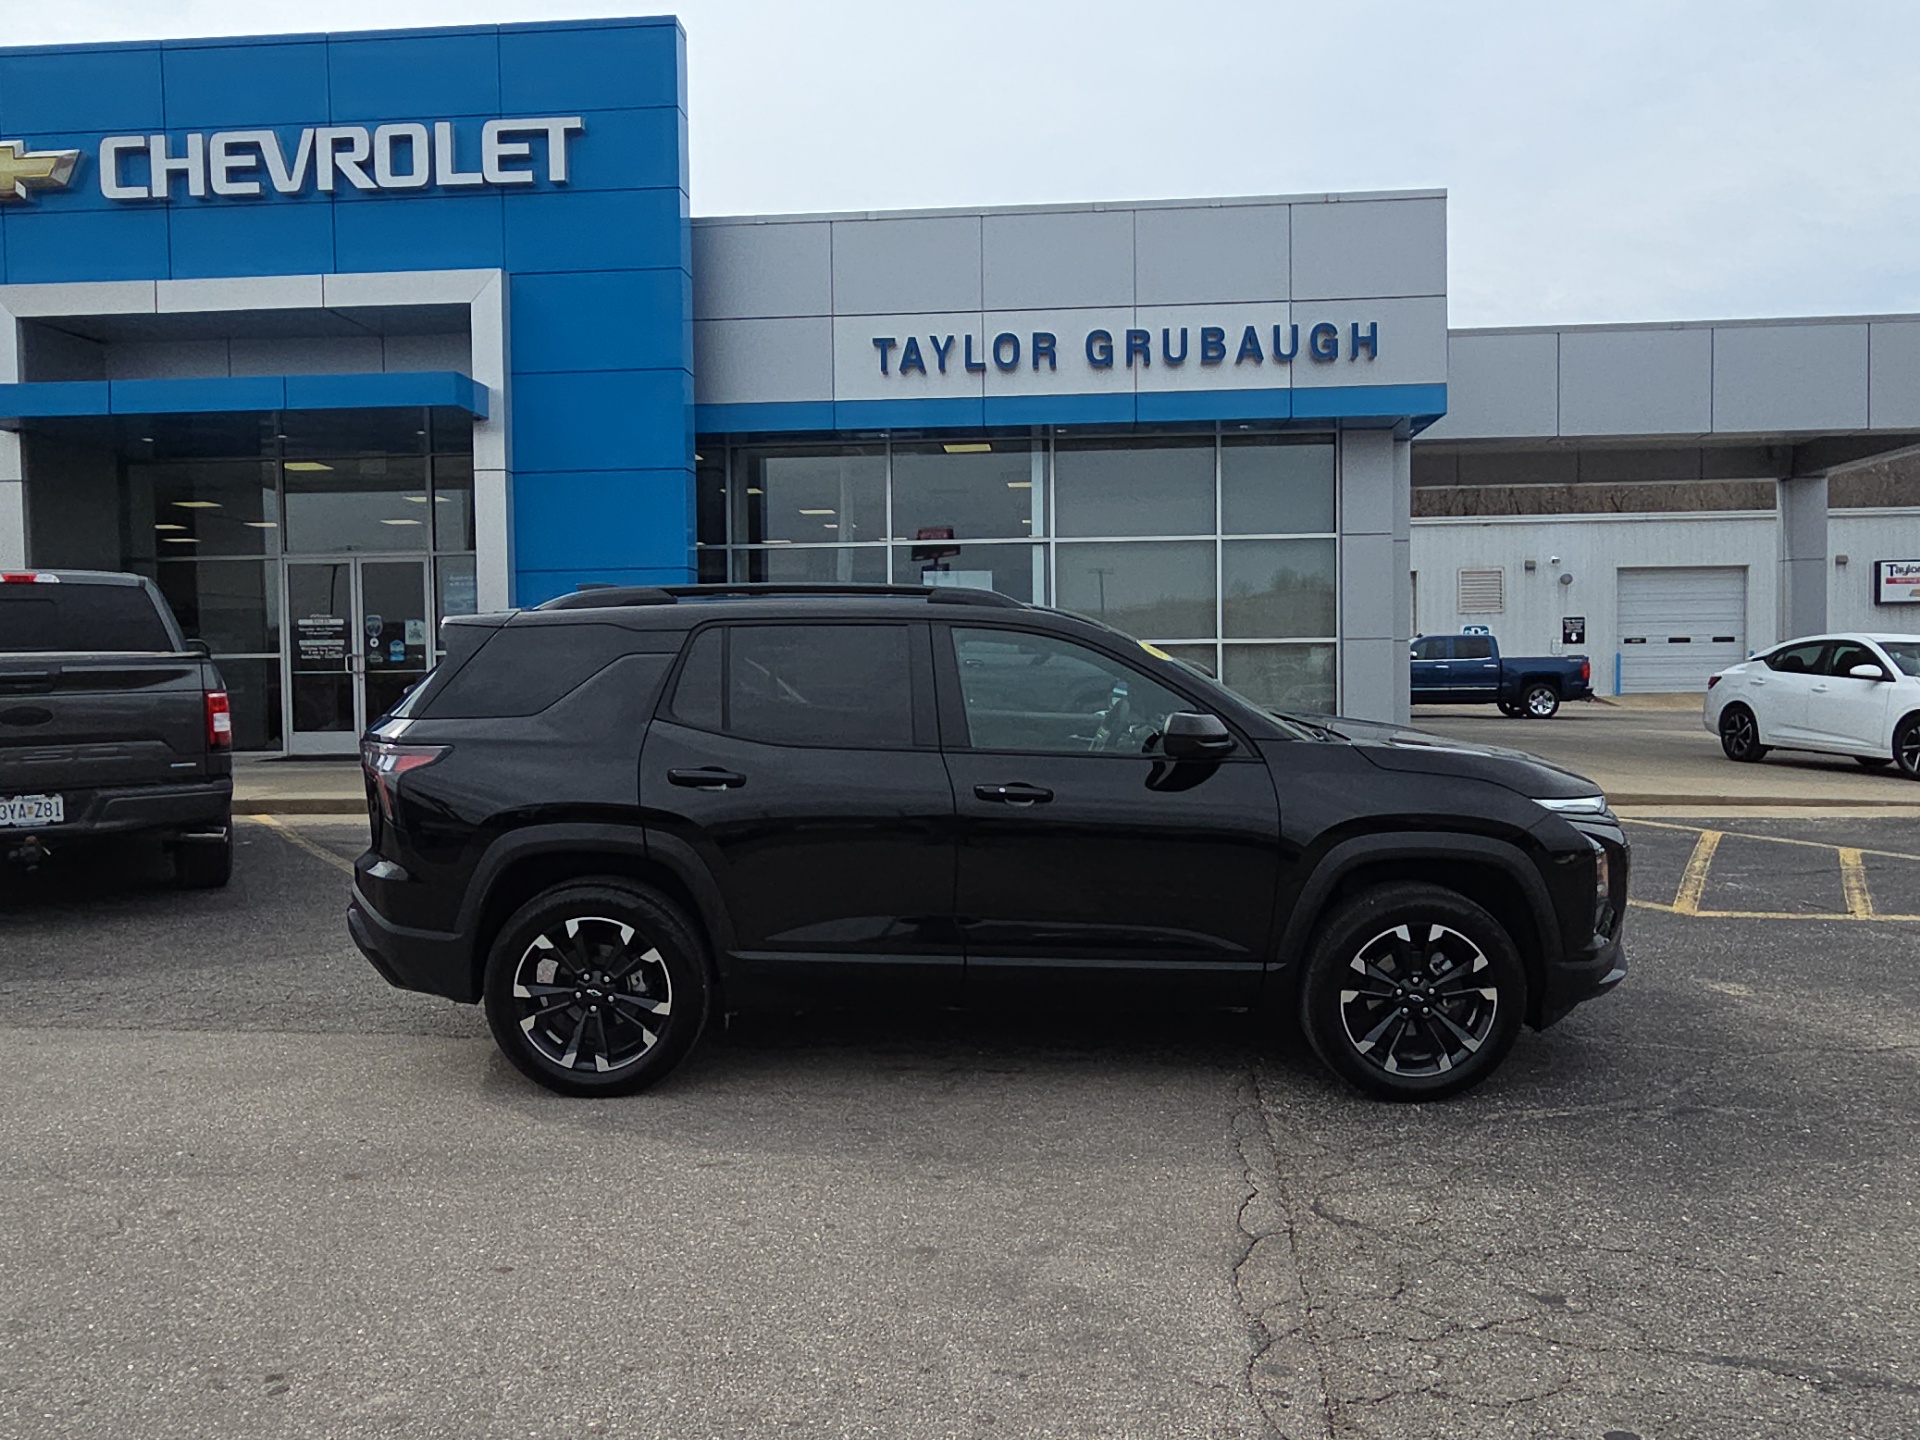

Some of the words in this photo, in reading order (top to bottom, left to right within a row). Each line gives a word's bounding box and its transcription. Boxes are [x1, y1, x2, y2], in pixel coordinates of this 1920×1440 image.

[100, 116, 582, 199] CHEVROLET
[872, 330, 1058, 374] TAYLOR
[1084, 321, 1378, 368] GRUBAUGH
